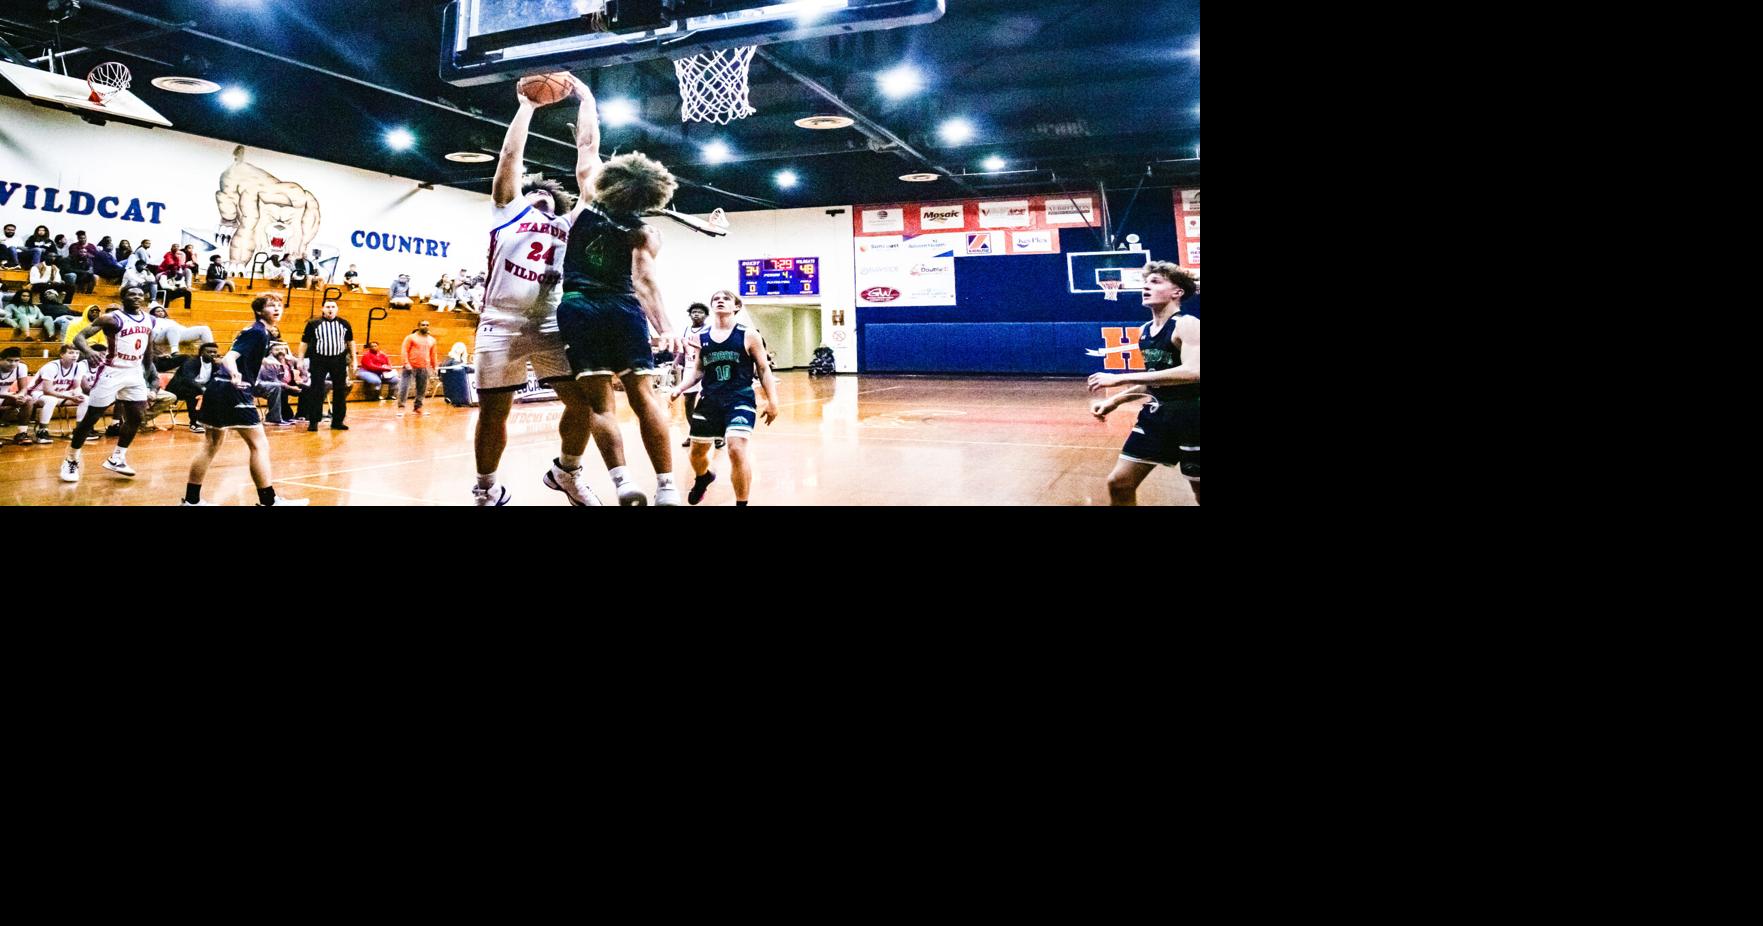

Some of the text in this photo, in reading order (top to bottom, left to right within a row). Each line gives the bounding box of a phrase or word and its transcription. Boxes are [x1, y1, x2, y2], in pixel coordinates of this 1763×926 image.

[923, 210, 960, 219] Mosaic
[351, 230, 450, 257] COUNTRY
[527, 242, 556, 266] 24
[770, 259, 792, 270] 7:29
[800, 264, 815, 274] 48
[745, 266, 759, 276] 34
[715, 365, 731, 381] 10
